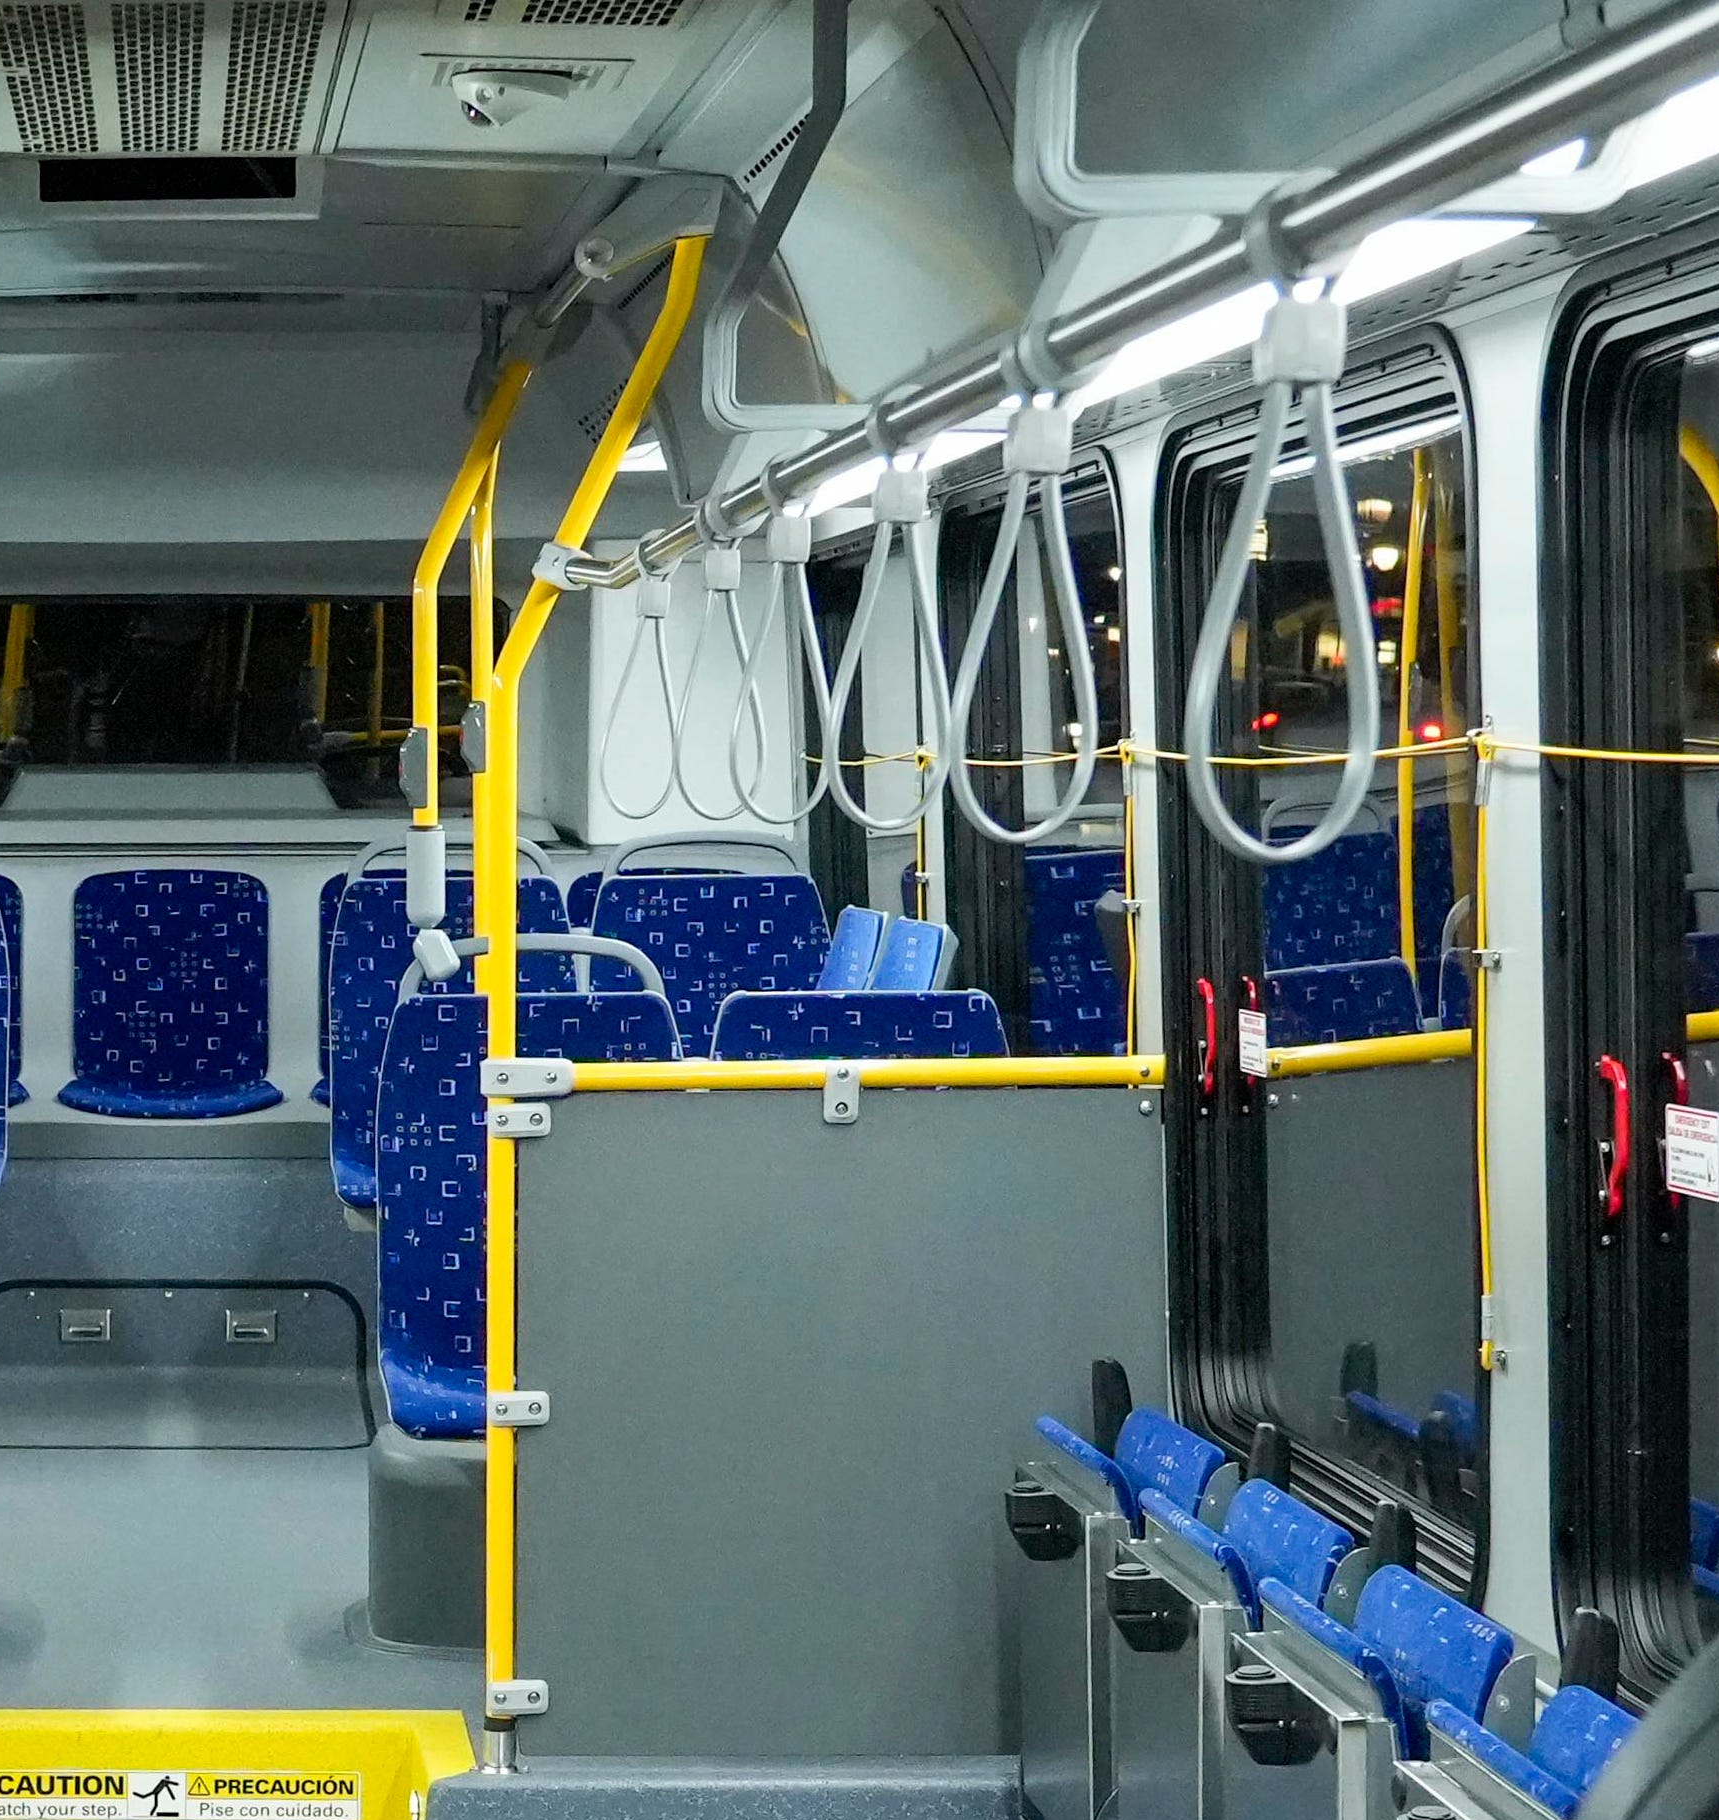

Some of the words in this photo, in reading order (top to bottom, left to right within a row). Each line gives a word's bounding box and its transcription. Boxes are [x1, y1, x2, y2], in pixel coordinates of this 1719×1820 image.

[214, 1776, 354, 1795] PRECAUCIÓN
[37, 1805, 75, 1819] your
[81, 1804, 122, 1819] step.
[199, 1802, 234, 1817] Pise
[239, 1805, 270, 1817] con
[276, 1803, 349, 1818] cuidado.
